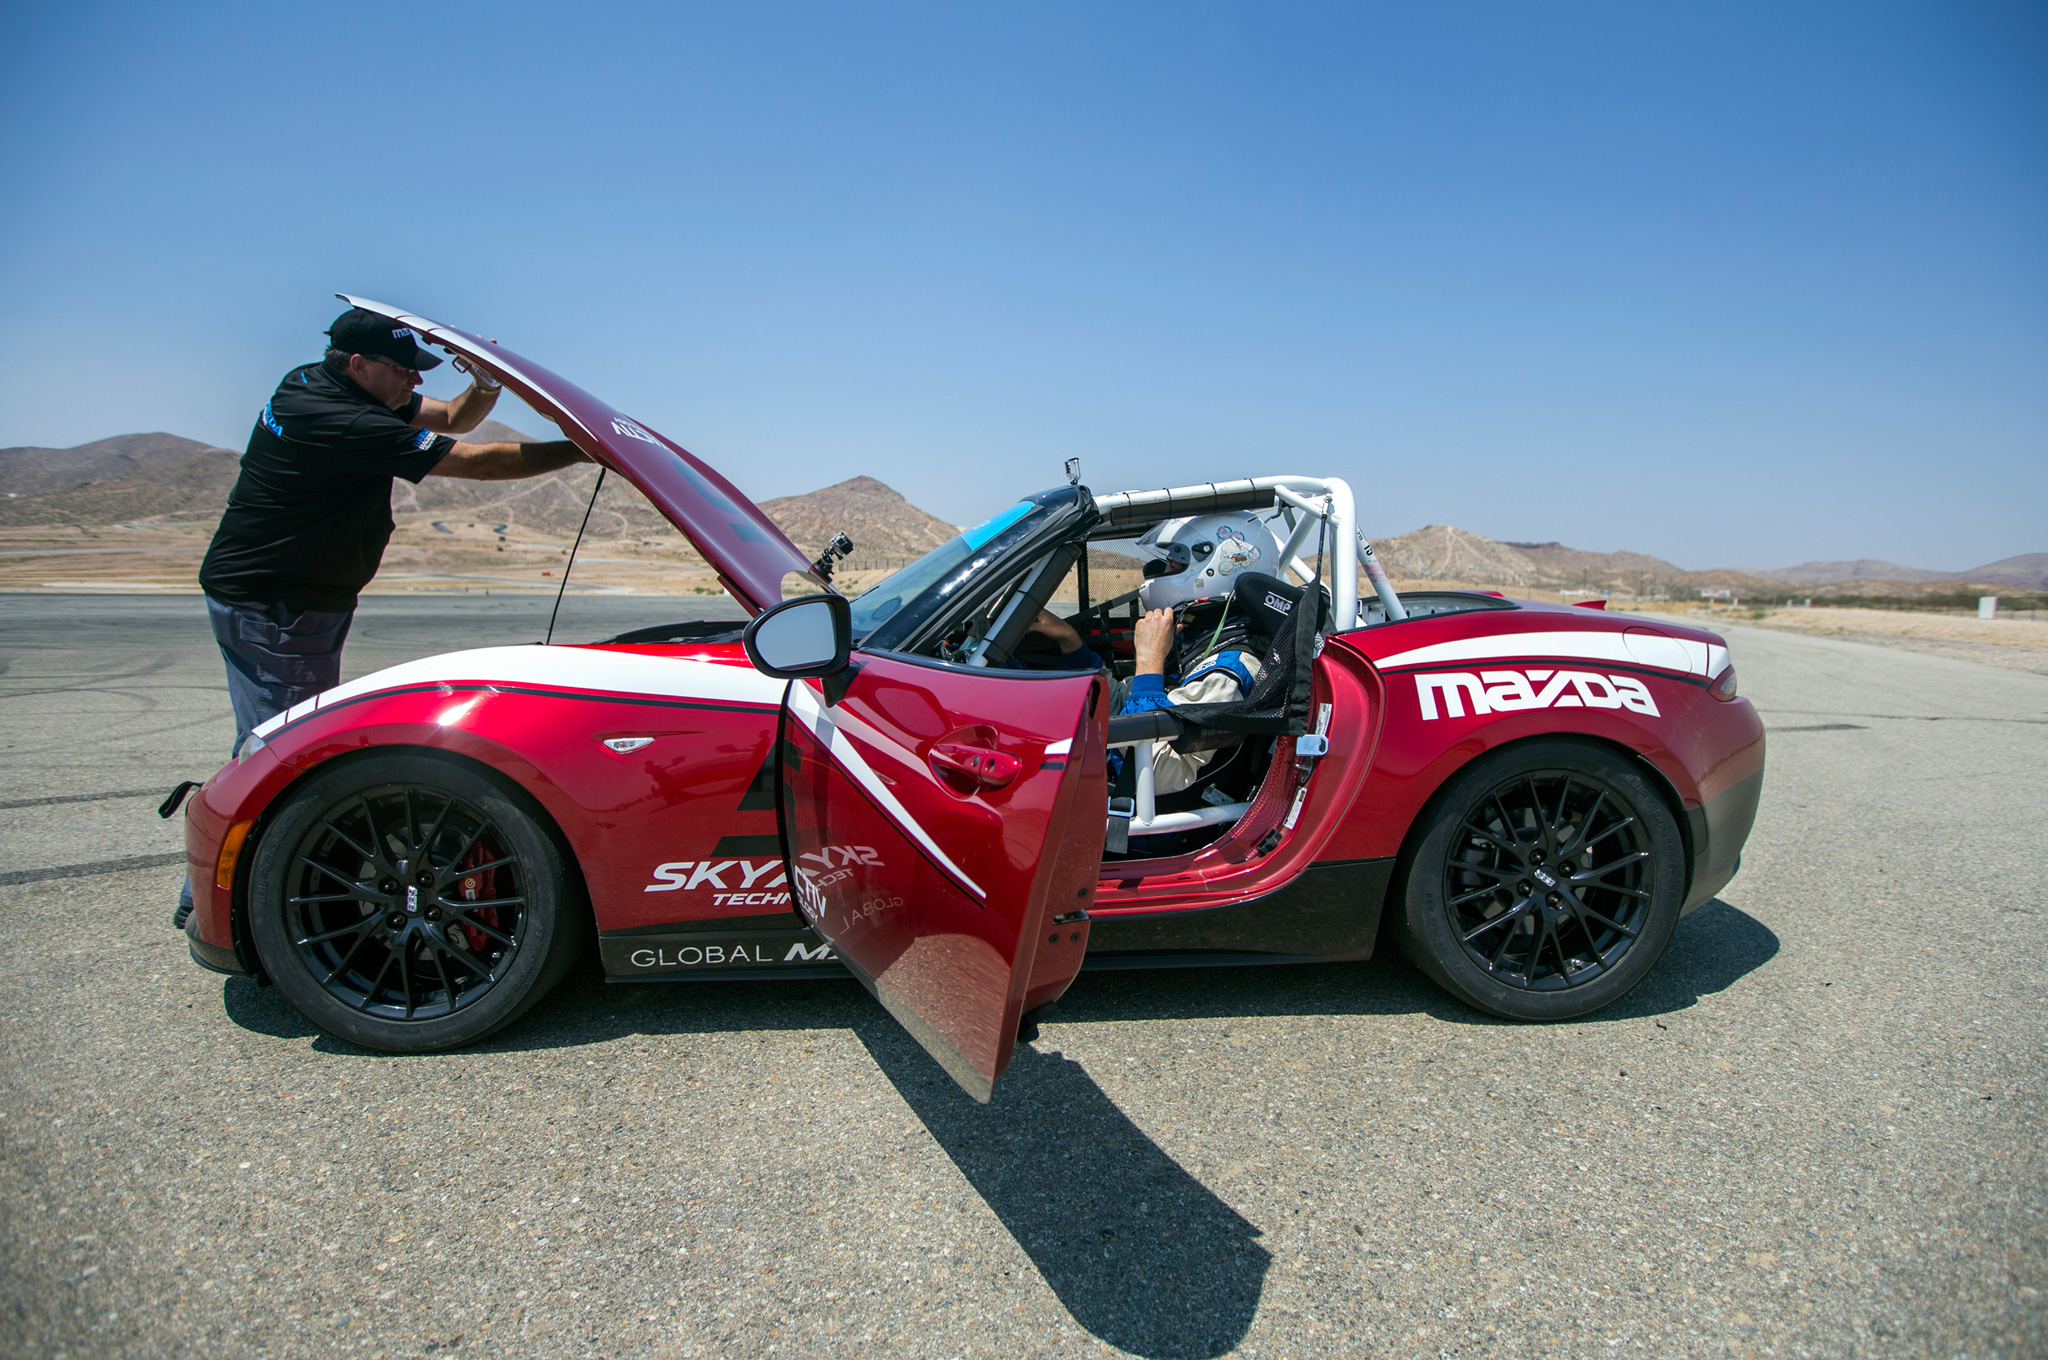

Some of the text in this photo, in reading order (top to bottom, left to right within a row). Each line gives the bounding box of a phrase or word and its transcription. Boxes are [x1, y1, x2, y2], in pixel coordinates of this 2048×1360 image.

[1265, 594, 1292, 612] OMP
[631, 942, 838, 967] GLOBAL M
